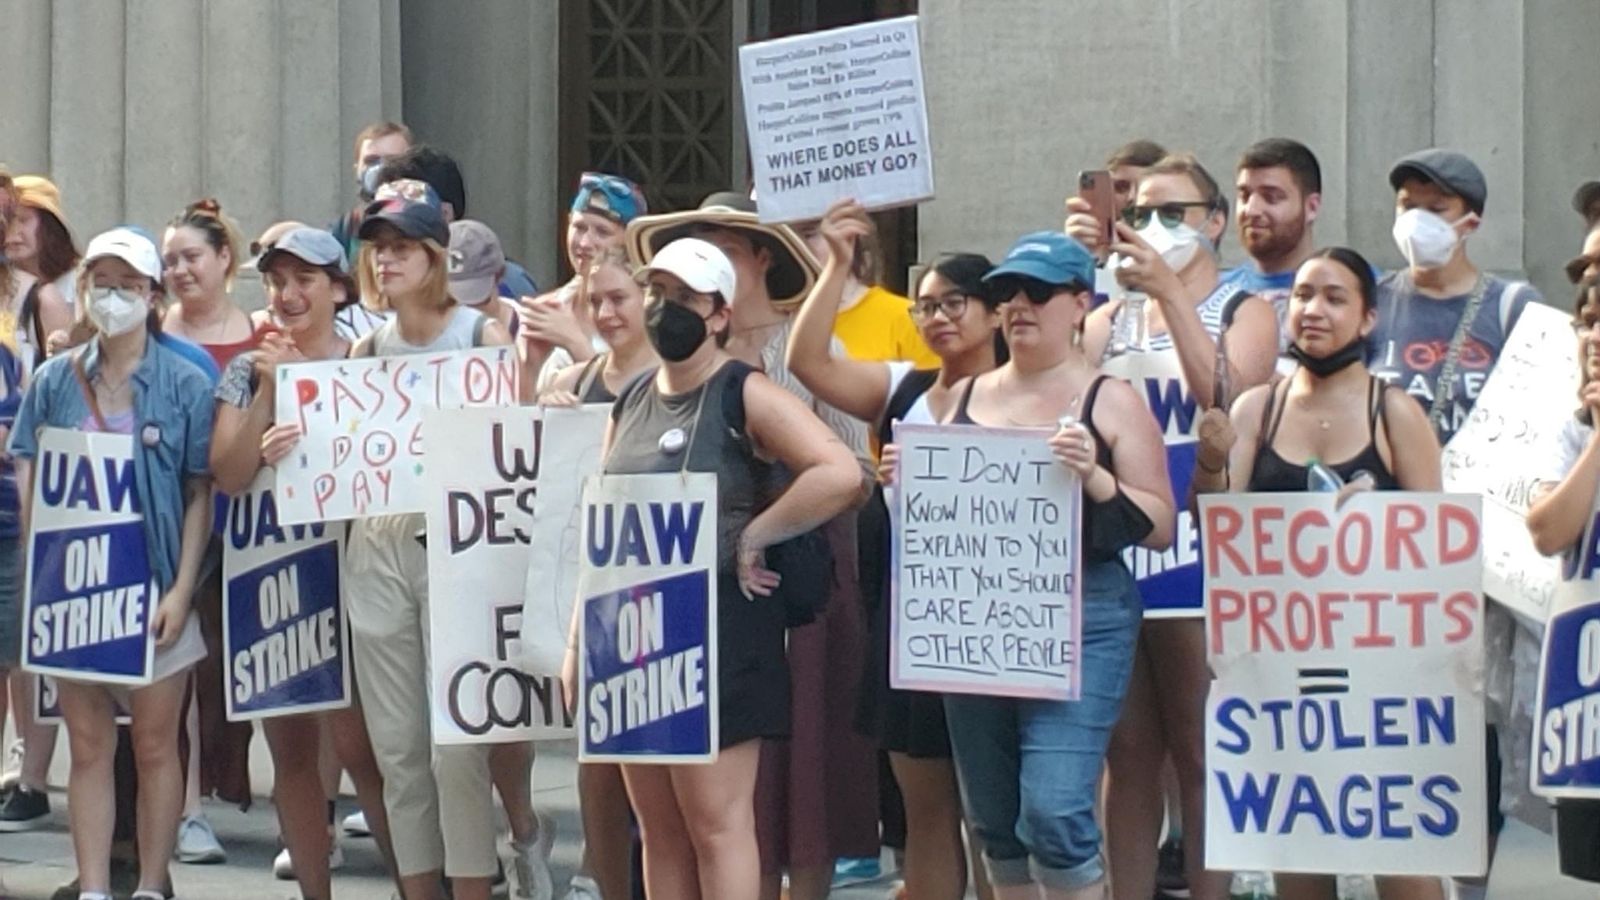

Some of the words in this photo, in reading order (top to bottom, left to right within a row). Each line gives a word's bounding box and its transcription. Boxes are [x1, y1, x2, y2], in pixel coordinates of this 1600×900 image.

[766, 146, 828, 170] WHERE
[833, 136, 880, 159] DOES
[884, 130, 917, 149] ALL
[769, 171, 817, 193] THAT
[818, 160, 876, 184] MONEY
[882, 152, 918, 172] GO?
[332, 422, 424, 469] DOE
[914, 446, 950, 481] I
[314, 469, 393, 518] PAY
[447, 487, 537, 555] DES
[905, 491, 957, 524] KNOW
[970, 495, 1018, 526] HOW
[1027, 497, 1059, 525] TO
[65, 533, 109, 592] ON
[587, 501, 704, 567] UAW
[904, 529, 988, 559] EXPLAIN
[994, 535, 1022, 556] TO
[1205, 503, 1481, 579] RECORD
[259, 565, 298, 630] ON
[904, 564, 963, 592] THAT
[31, 584, 145, 658] STRIKE
[618, 591, 665, 664] ON
[904, 598, 977, 625] CARE
[984, 600, 1064, 629] ABOUT
[1208, 587, 1479, 656] PROFITS
[233, 606, 337, 704] STRIKE
[906, 633, 1000, 670] OTHER
[1002, 633, 1076, 668] PEOPLE
[1577, 618, 1600, 687] O
[448, 661, 574, 735] CON
[590, 645, 704, 745] STRIKE
[1214, 695, 1457, 755] STOLEN
[1541, 692, 1600, 776] STR
[1213, 768, 1462, 839] WAGES
